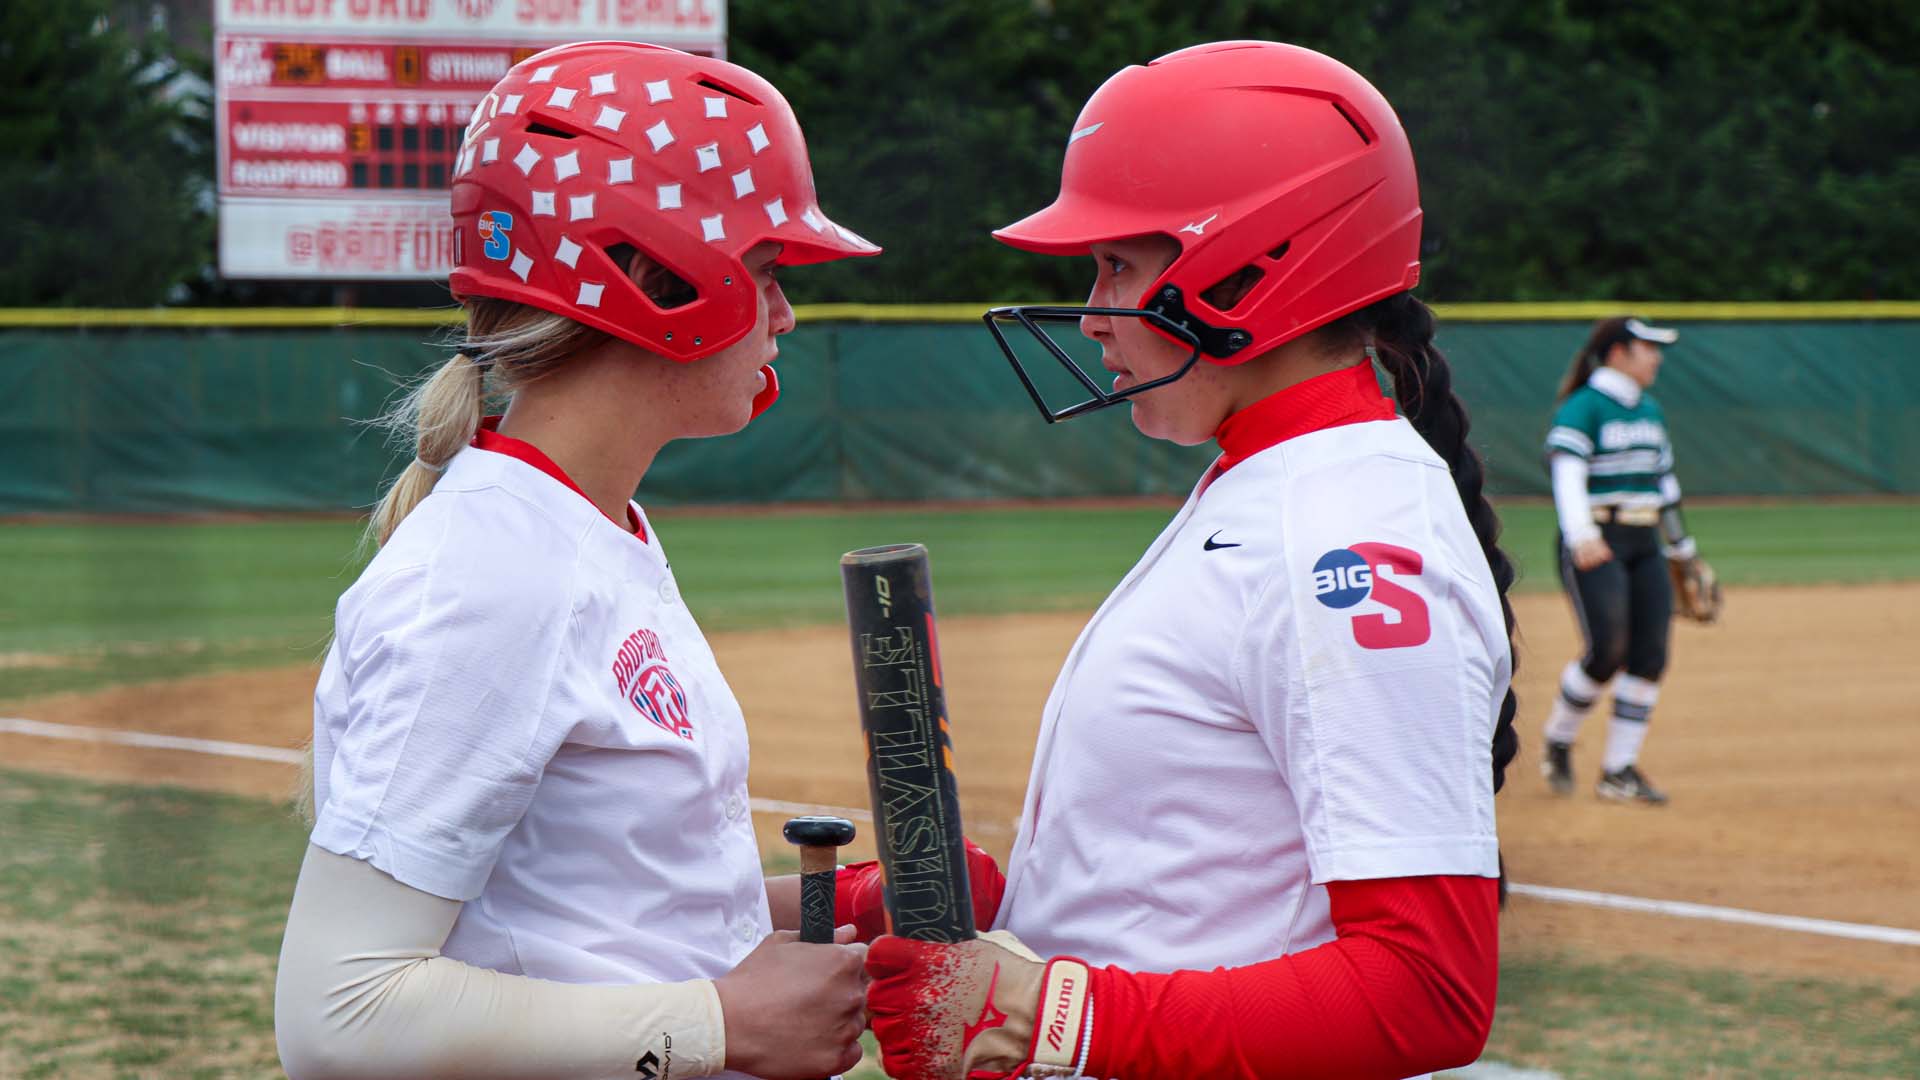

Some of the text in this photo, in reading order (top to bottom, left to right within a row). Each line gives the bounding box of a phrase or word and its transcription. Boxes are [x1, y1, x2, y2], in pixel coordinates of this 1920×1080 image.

[325, 48, 389, 81] BALL
[232, 122, 346, 152] VISITOR
[231, 161, 346, 188] RADFORD
[289, 221, 454, 273] @RADFOR
[876, 575, 893, 619] -10
[1312, 541, 1432, 650] BIG S
[612, 628, 669, 699] RADFORD
